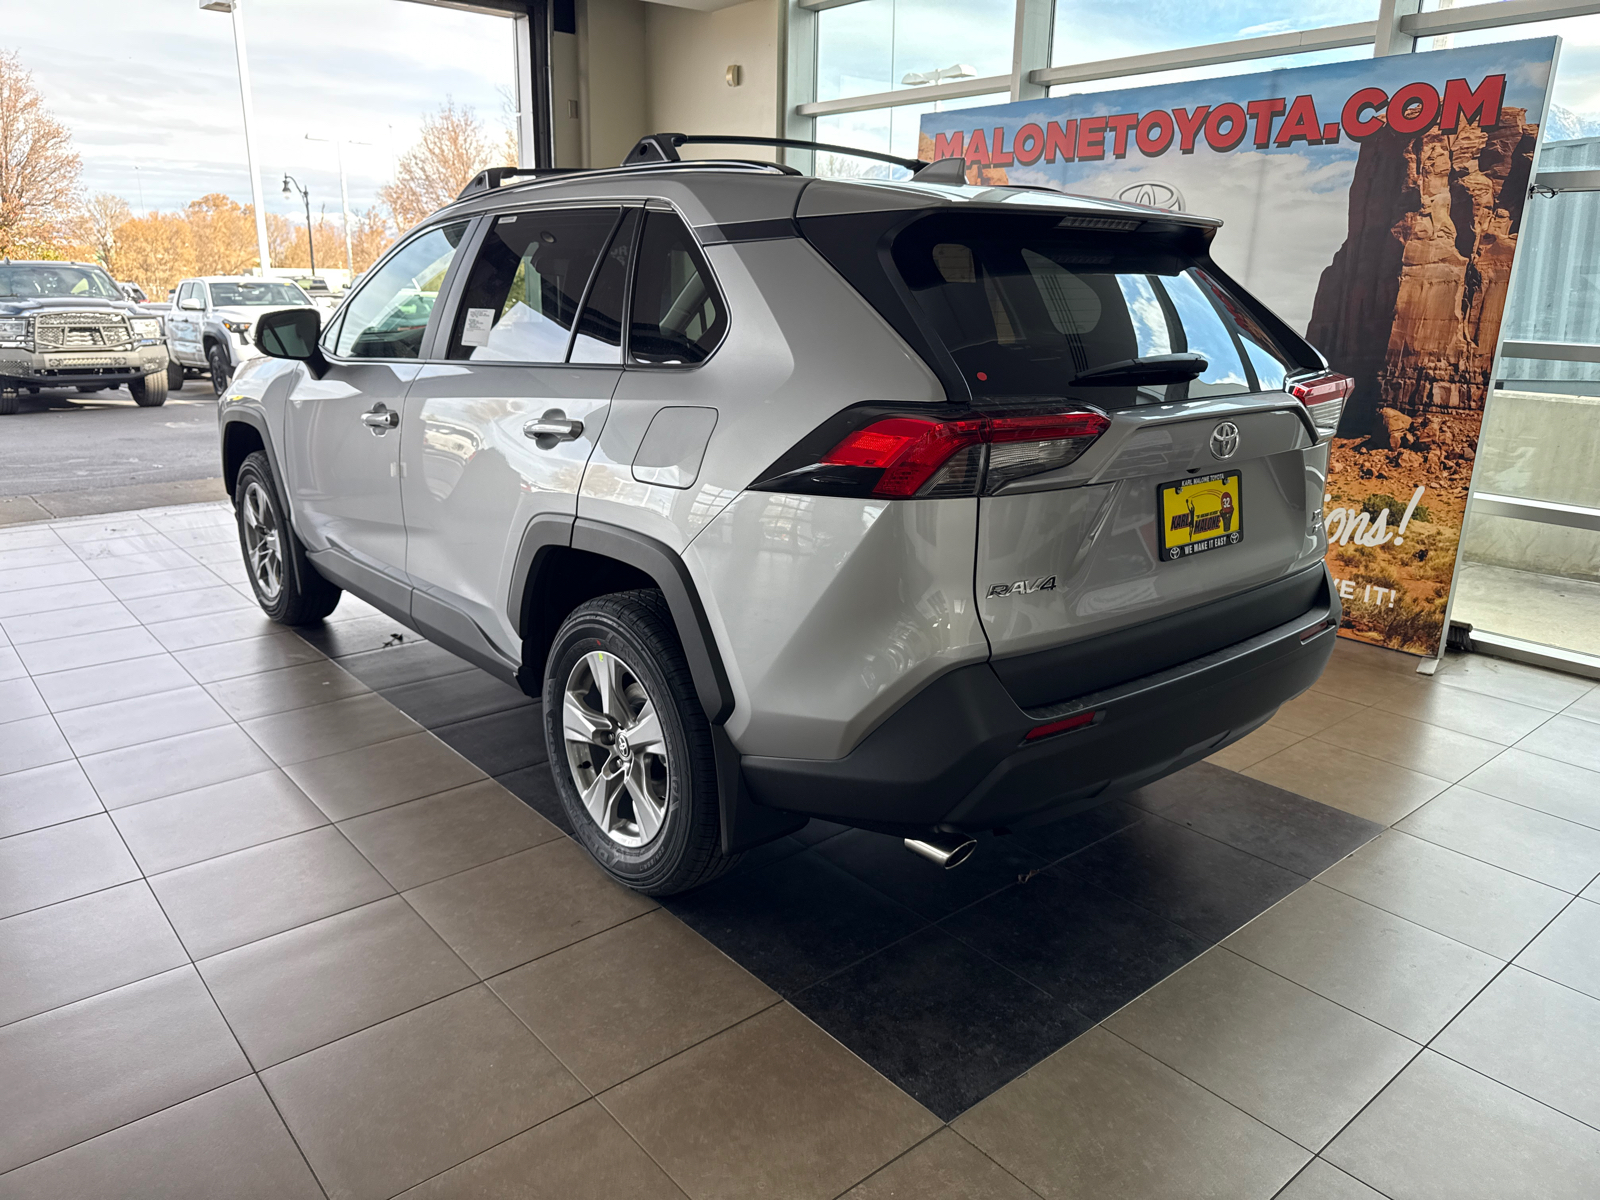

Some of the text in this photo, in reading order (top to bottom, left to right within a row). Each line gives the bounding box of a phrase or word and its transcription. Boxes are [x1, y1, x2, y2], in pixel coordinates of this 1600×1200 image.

[933, 73, 1507, 169] MALONETOYOTA.COM
[1182, 473, 1224, 487] KARL MALONE TOYOTA
[1223, 498, 1231, 508] 32
[1170, 513, 1190, 531] KARL
[1193, 515, 1221, 535] MALONE
[1324, 486, 1426, 547] ons!
[1184, 536, 1227, 554] WE MAKE IT EASY
[986, 574, 1057, 599] RAV4
[1363, 584, 1397, 609] IT!
